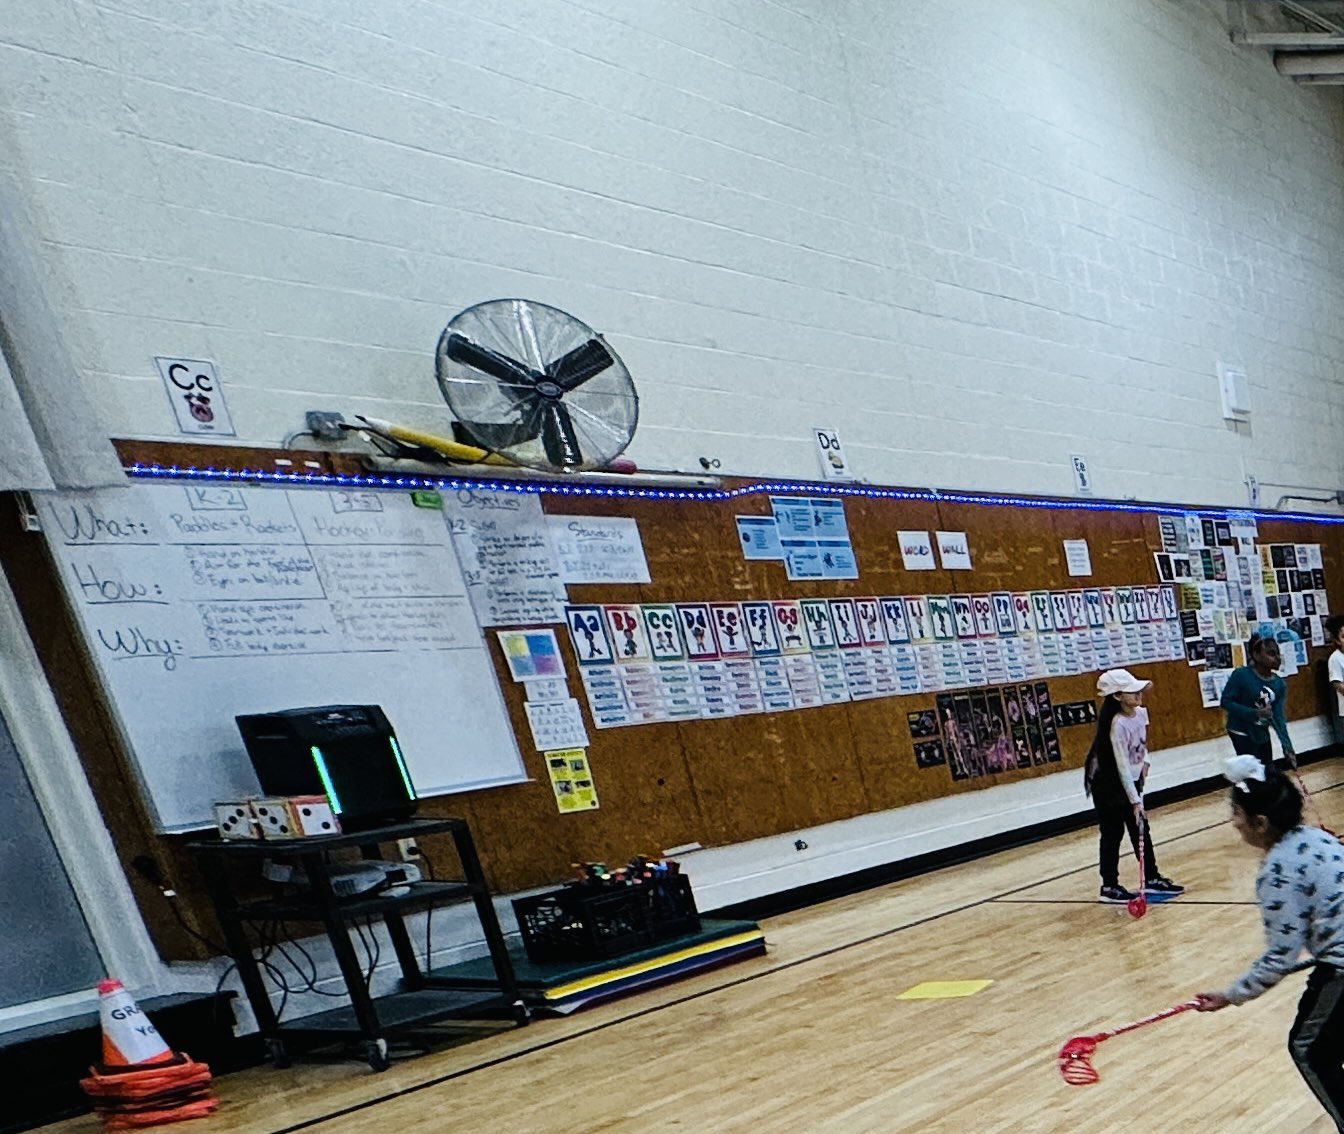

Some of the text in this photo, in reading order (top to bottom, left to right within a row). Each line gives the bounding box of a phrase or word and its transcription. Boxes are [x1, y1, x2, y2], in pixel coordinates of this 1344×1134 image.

[169, 364, 213, 392] Cc
[818, 432, 840, 450] Dd
[195, 488, 242, 505] K-2
[51, 503, 149, 540] What:
[904, 545, 966, 556] WORD WALL
[71, 563, 162, 600] How:
[574, 614, 599, 632] Aa
[612, 612, 637, 631] Bb
[649, 611, 673, 629] Cc
[683, 610, 707, 629] Dd
[716, 609, 738, 627] Ee
[750, 608, 767, 627] Ff
[97, 627, 183, 671] Why:
